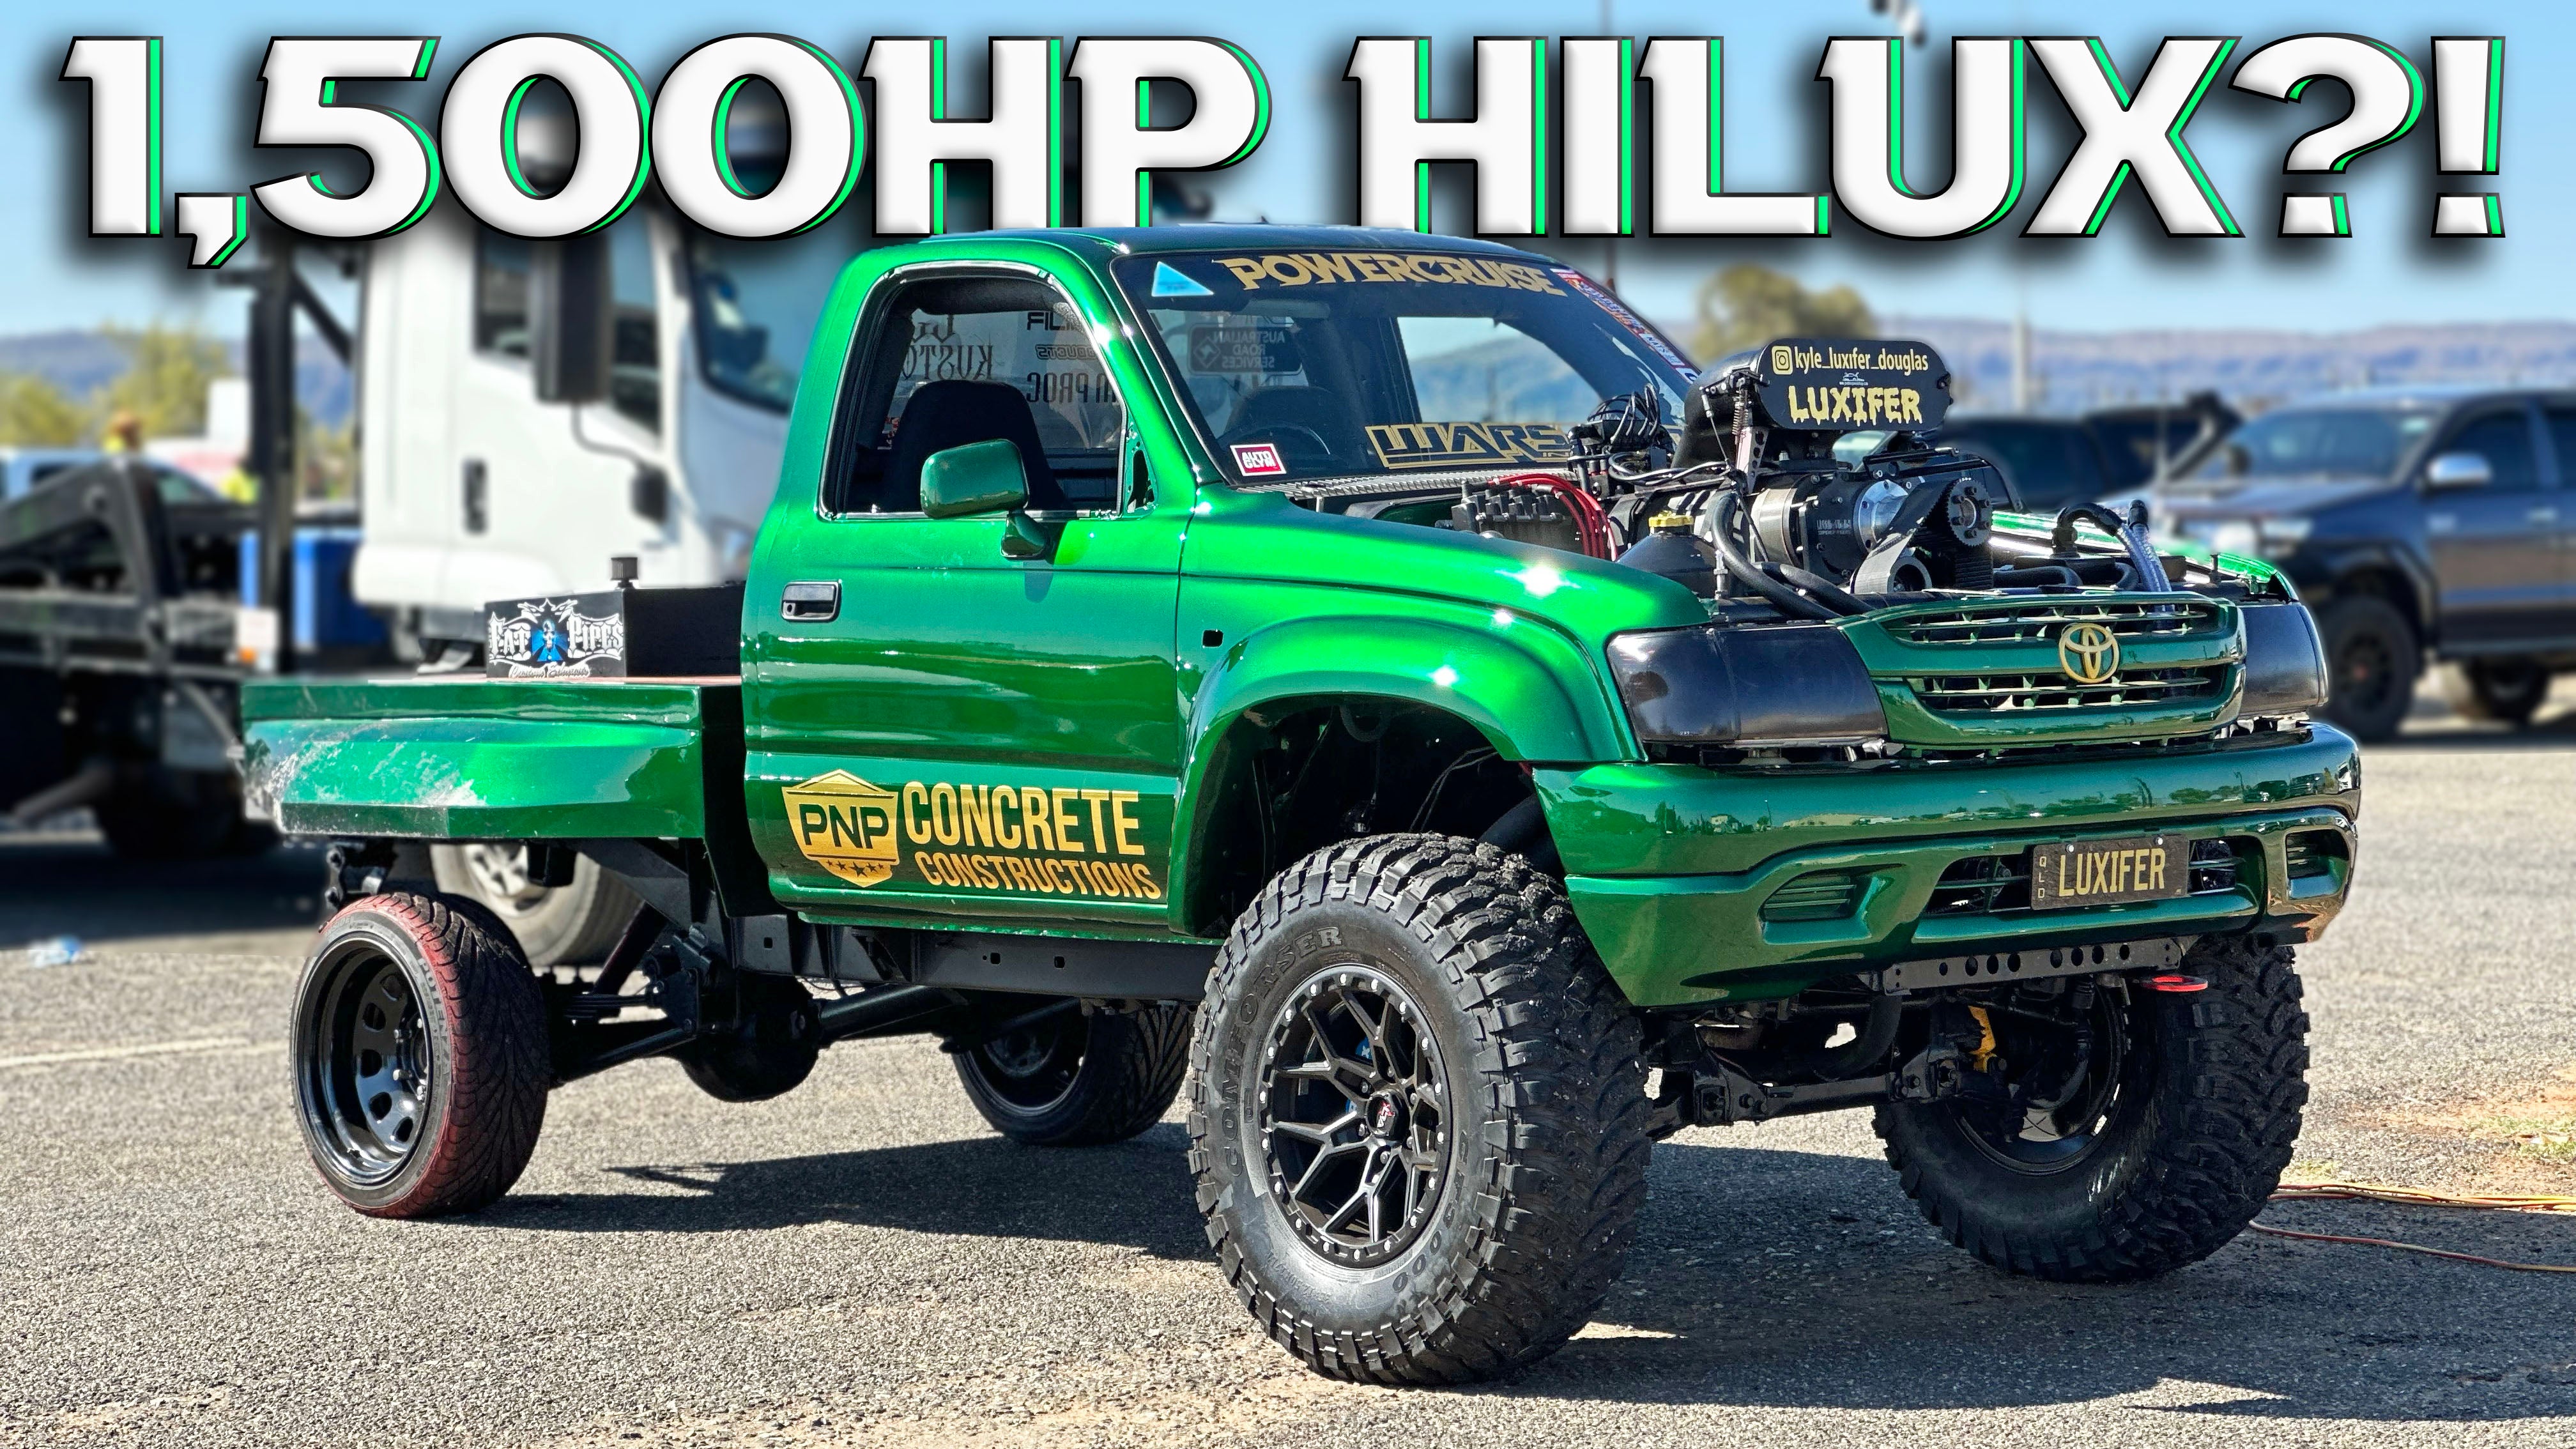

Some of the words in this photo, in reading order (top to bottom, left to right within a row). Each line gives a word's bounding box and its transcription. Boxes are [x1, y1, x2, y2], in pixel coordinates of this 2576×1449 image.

[1212, 253, 1568, 297] POWERCRUISE
[1794, 346, 1928, 376] kyle_luxifer_douglas
[1788, 385, 1922, 426] LUXIFER
[798, 804, 889, 850] PNP
[903, 781, 1144, 855] CONCRETE
[914, 851, 1162, 900] CONSTRUCTIONS
[2058, 848, 2166, 897] LUXIFER
